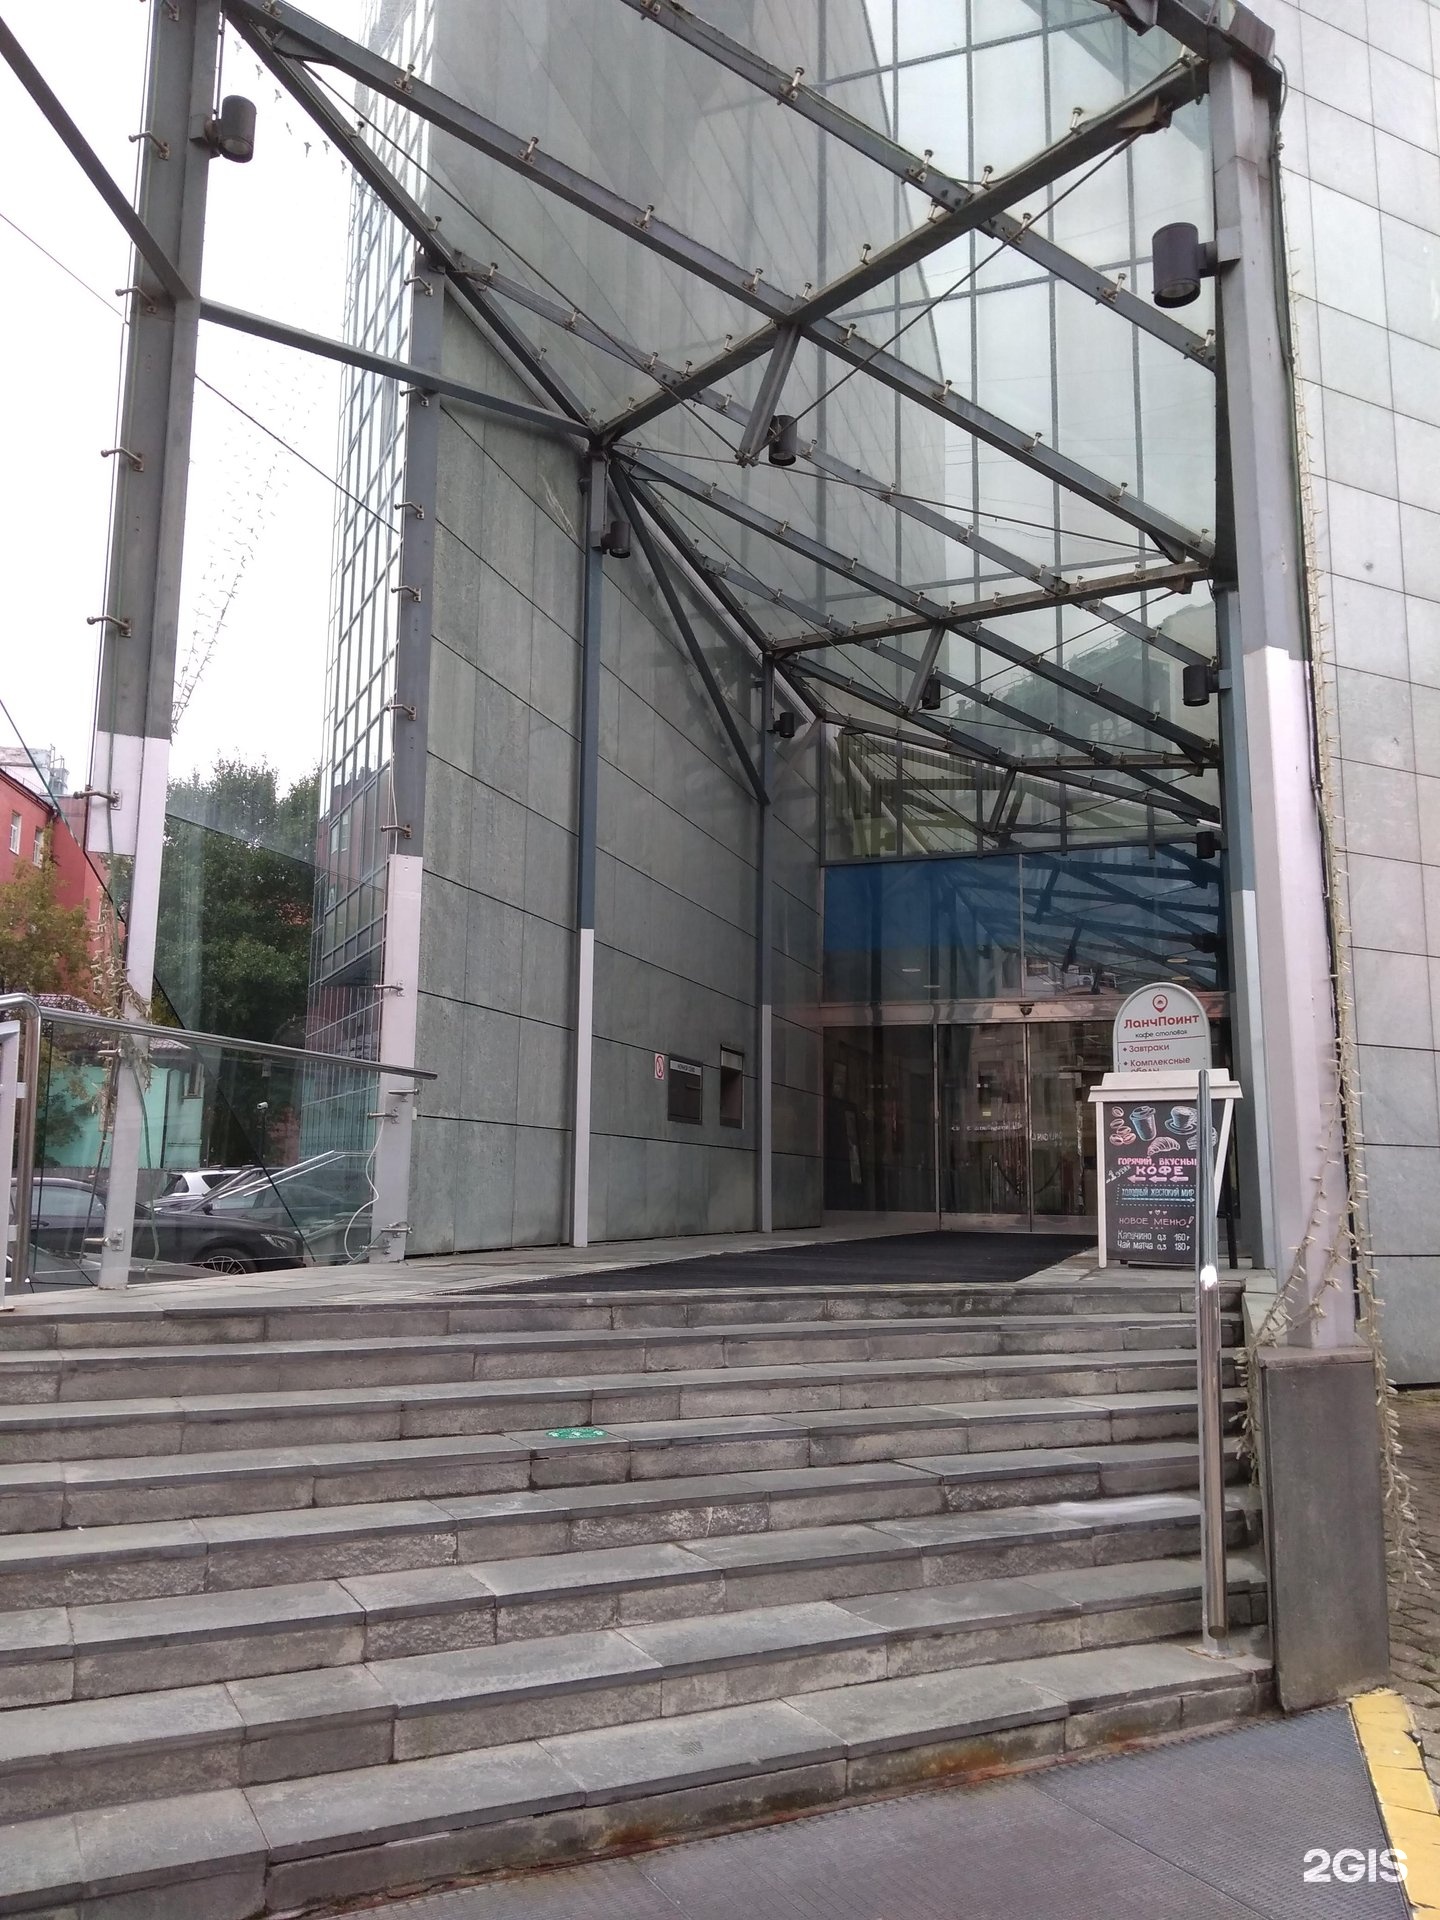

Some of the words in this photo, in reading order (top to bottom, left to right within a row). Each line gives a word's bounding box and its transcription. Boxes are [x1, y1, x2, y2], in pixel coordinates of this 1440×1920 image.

[1124, 1015, 1199, 1029] ЛанчПоинт
[1155, 1029, 1187, 1037] столовая
[1129, 1045, 1170, 1053] Завтраки
[1130, 1057, 1190, 1067] Комплексные
[1159, 1157, 1197, 1166] ВКУСНЫ
[1136, 1166, 1184, 1175] КОФЕ
[1119, 1217, 1149, 1225] НОВОЕ
[1117, 1240, 1131, 1249] Чай
